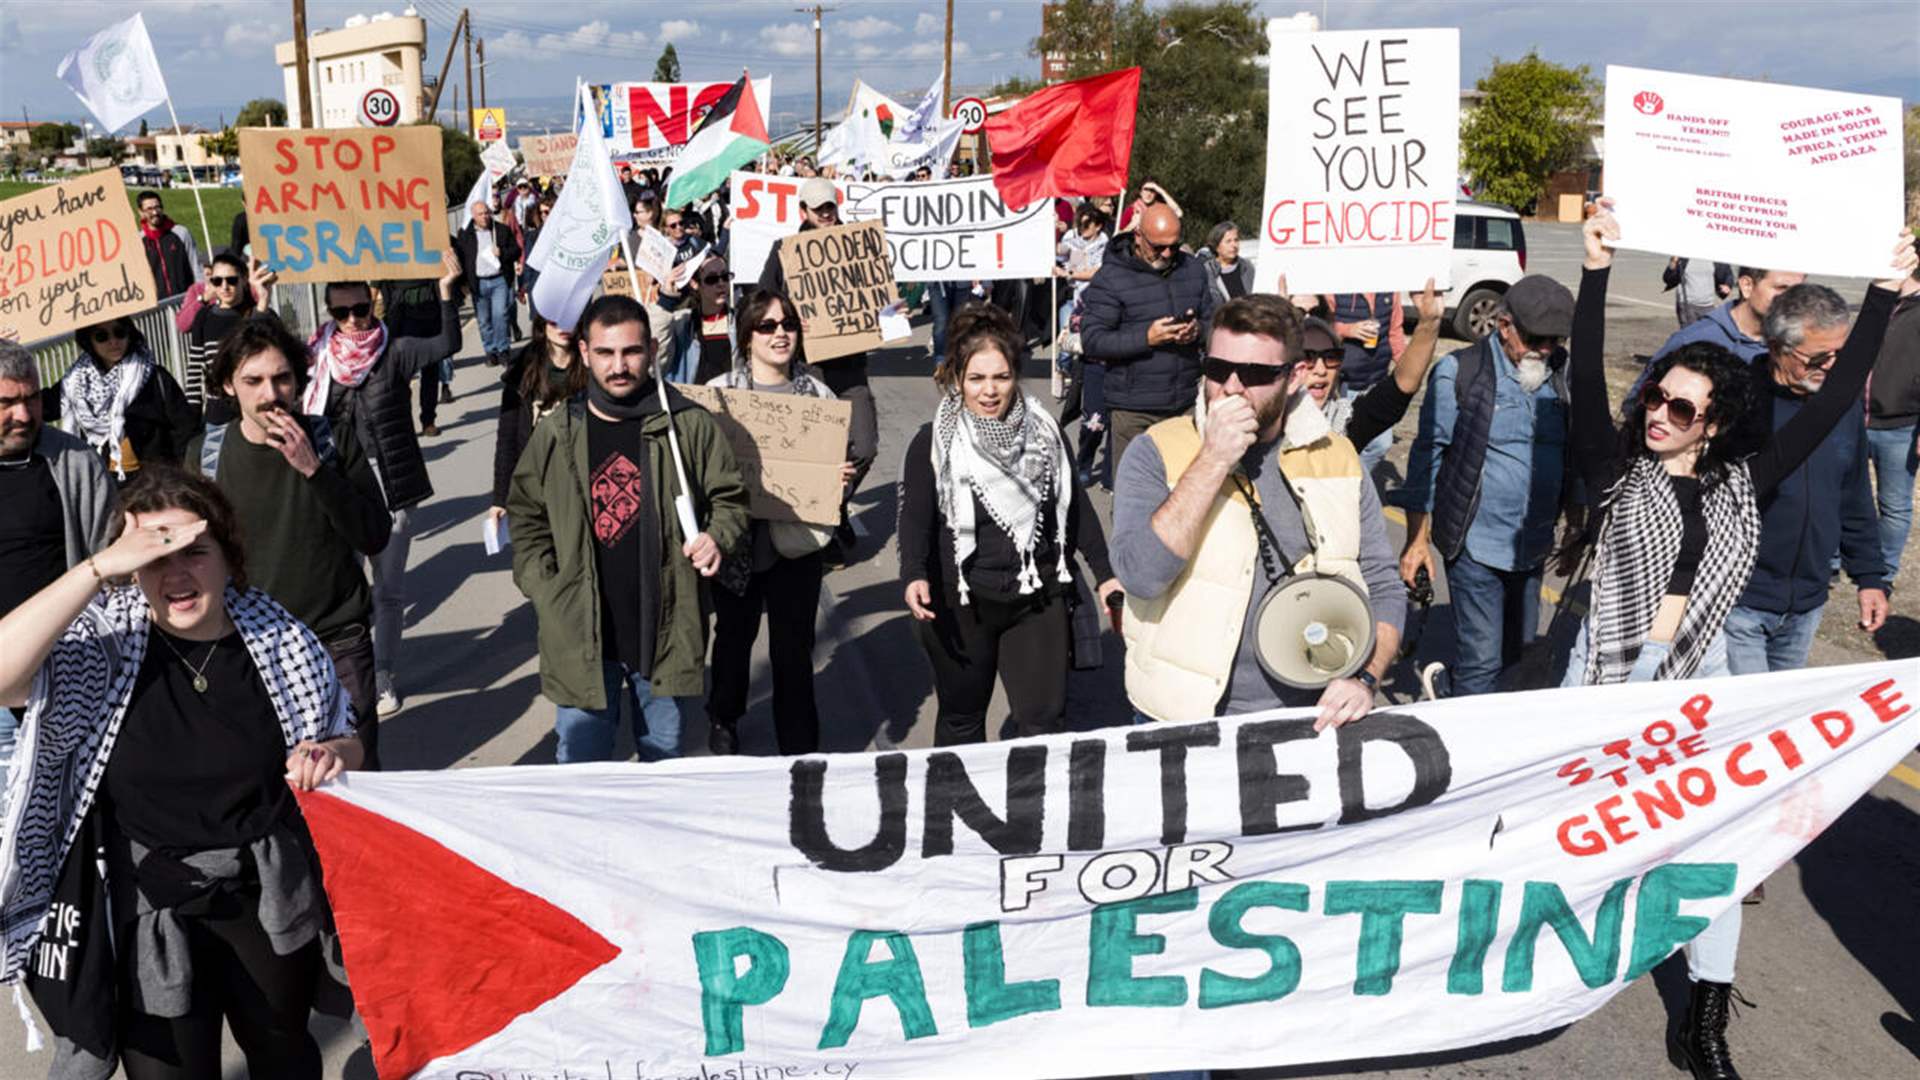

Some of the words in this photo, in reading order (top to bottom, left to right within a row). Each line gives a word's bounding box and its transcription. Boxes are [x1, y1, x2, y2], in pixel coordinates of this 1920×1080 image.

[1311, 38, 1410, 91] WE
[369, 97, 392, 115] 30
[1312, 94, 1405, 140] SEE
[1666, 113, 1706, 124] HANDS
[1708, 118, 1730, 126] OFF
[1780, 111, 1842, 131] COURAGE
[1842, 105, 1872, 118] WAS
[1782, 129, 1819, 143] MADE
[1821, 126, 1836, 136] IN
[1838, 116, 1881, 133] SOUTH
[1788, 140, 1835, 156] AFRICA
[1842, 128, 1888, 144] YEMEN
[274, 134, 396, 175] STOP
[1311, 138, 1428, 192] YOUR
[1811, 153, 1838, 166] AND
[1839, 144, 1877, 159] GAZA
[0, 204, 46, 252] you
[52, 186, 107, 216] have
[254, 177, 430, 221] ARMING
[881, 189, 1030, 227] FUNDIN
[1686, 207, 1705, 217] WE
[1706, 211, 1762, 226] CONDEMN
[1765, 220, 1798, 231] YOUR
[1696, 187, 1742, 201] BRITISH
[1744, 194, 1788, 207] FORCES
[1696, 198, 1719, 208] OUT
[1721, 202, 1737, 210] OF
[1267, 199, 1450, 244] GENOCIDE
[1706, 221, 1777, 239] ATROCITIES!
[14, 218, 122, 288] BLOOD
[258, 219, 442, 272] ISRAEL
[794, 234, 842, 272] 100
[841, 226, 883, 262] DEAD
[0, 290, 32, 315] on
[38, 268, 99, 326] your
[64, 263, 145, 321] hands
[800, 302, 818, 319] IN
[825, 289, 870, 318] GAZA
[871, 287, 891, 308] IN
[1556, 693, 1714, 786] STOP
[1599, 733, 1710, 788] THE
[1556, 677, 1912, 857] GENOCIDE
[788, 711, 1453, 873] UNITED
[998, 840, 1235, 913] FOR
[692, 862, 1738, 1058] PALESTINE
